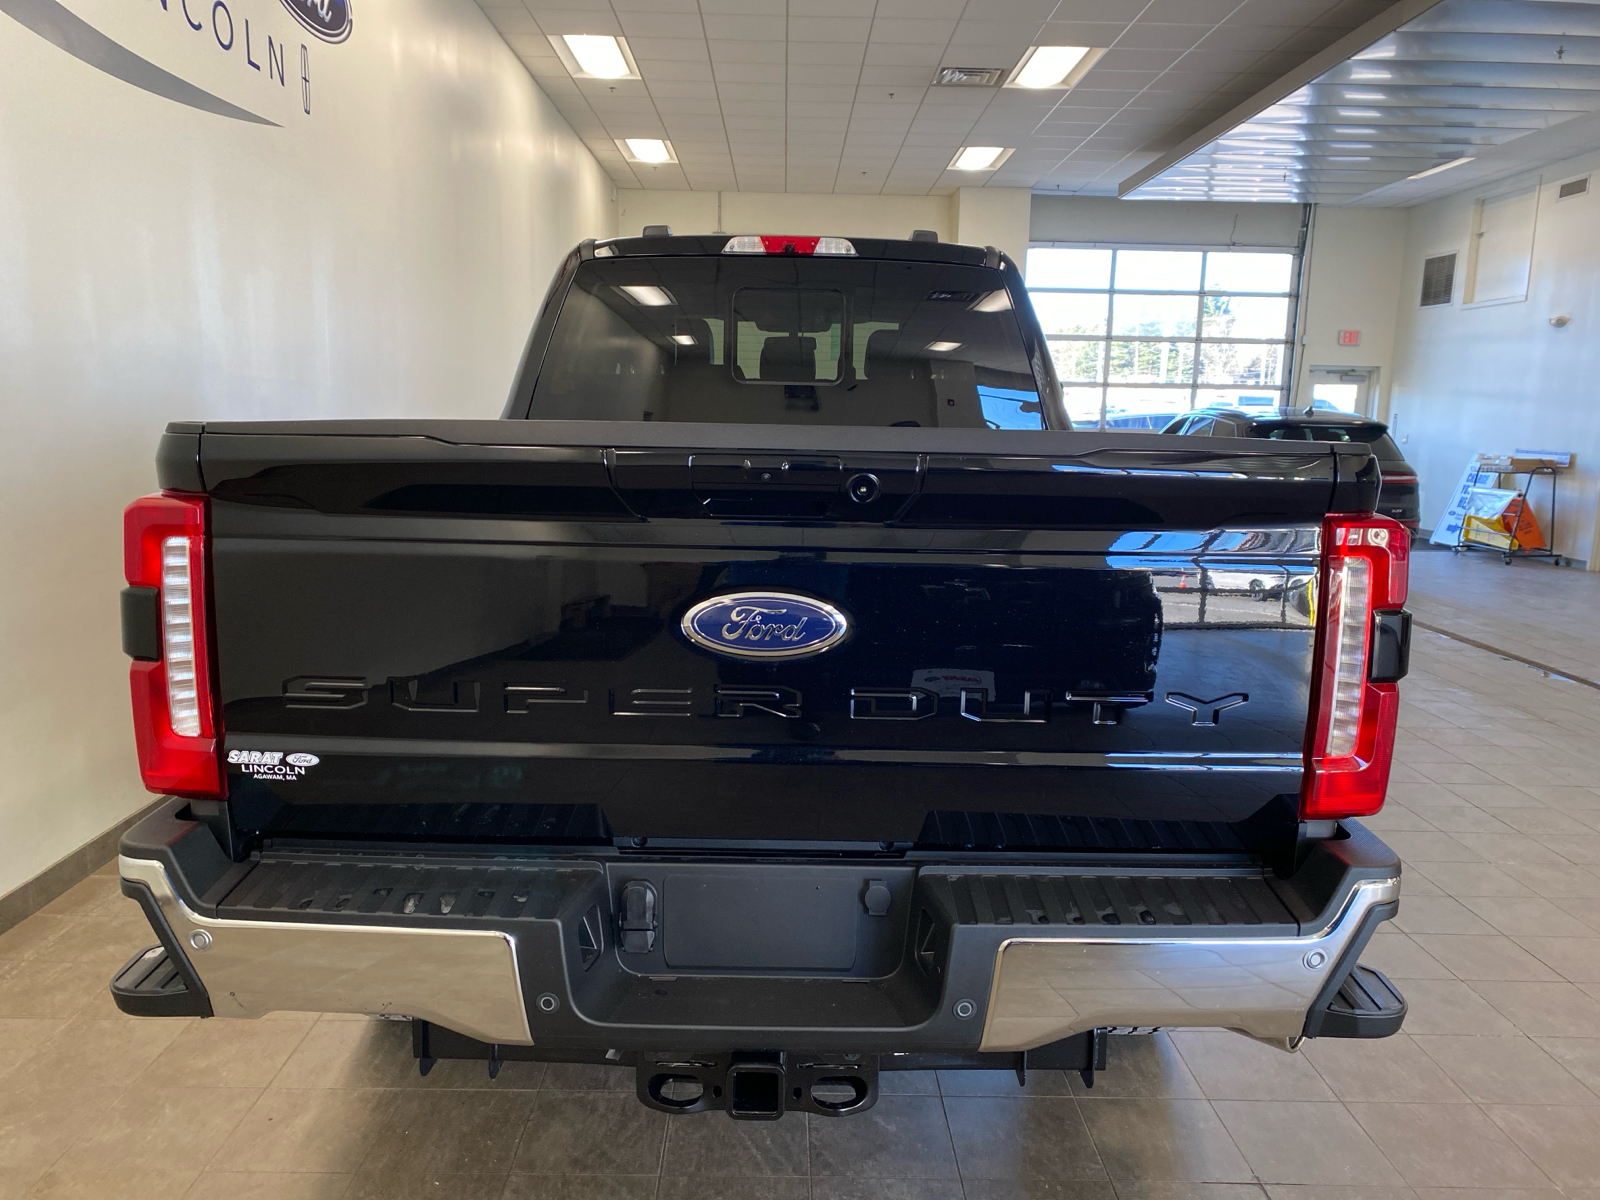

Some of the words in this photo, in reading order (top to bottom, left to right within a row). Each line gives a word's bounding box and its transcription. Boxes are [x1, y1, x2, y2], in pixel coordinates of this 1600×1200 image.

[160, 0, 285, 87] COLN
[1342, 330, 1360, 344] EXIT
[1466, 472, 1491, 485] CHRGE
[721, 605, 808, 642] Ford
[281, 674, 802, 718] SUPER
[850, 686, 1249, 727] DUTY
[227, 749, 283, 765] SARAT
[241, 764, 306, 775] LINCOLN
[253, 773, 285, 781] AGAWAM,
